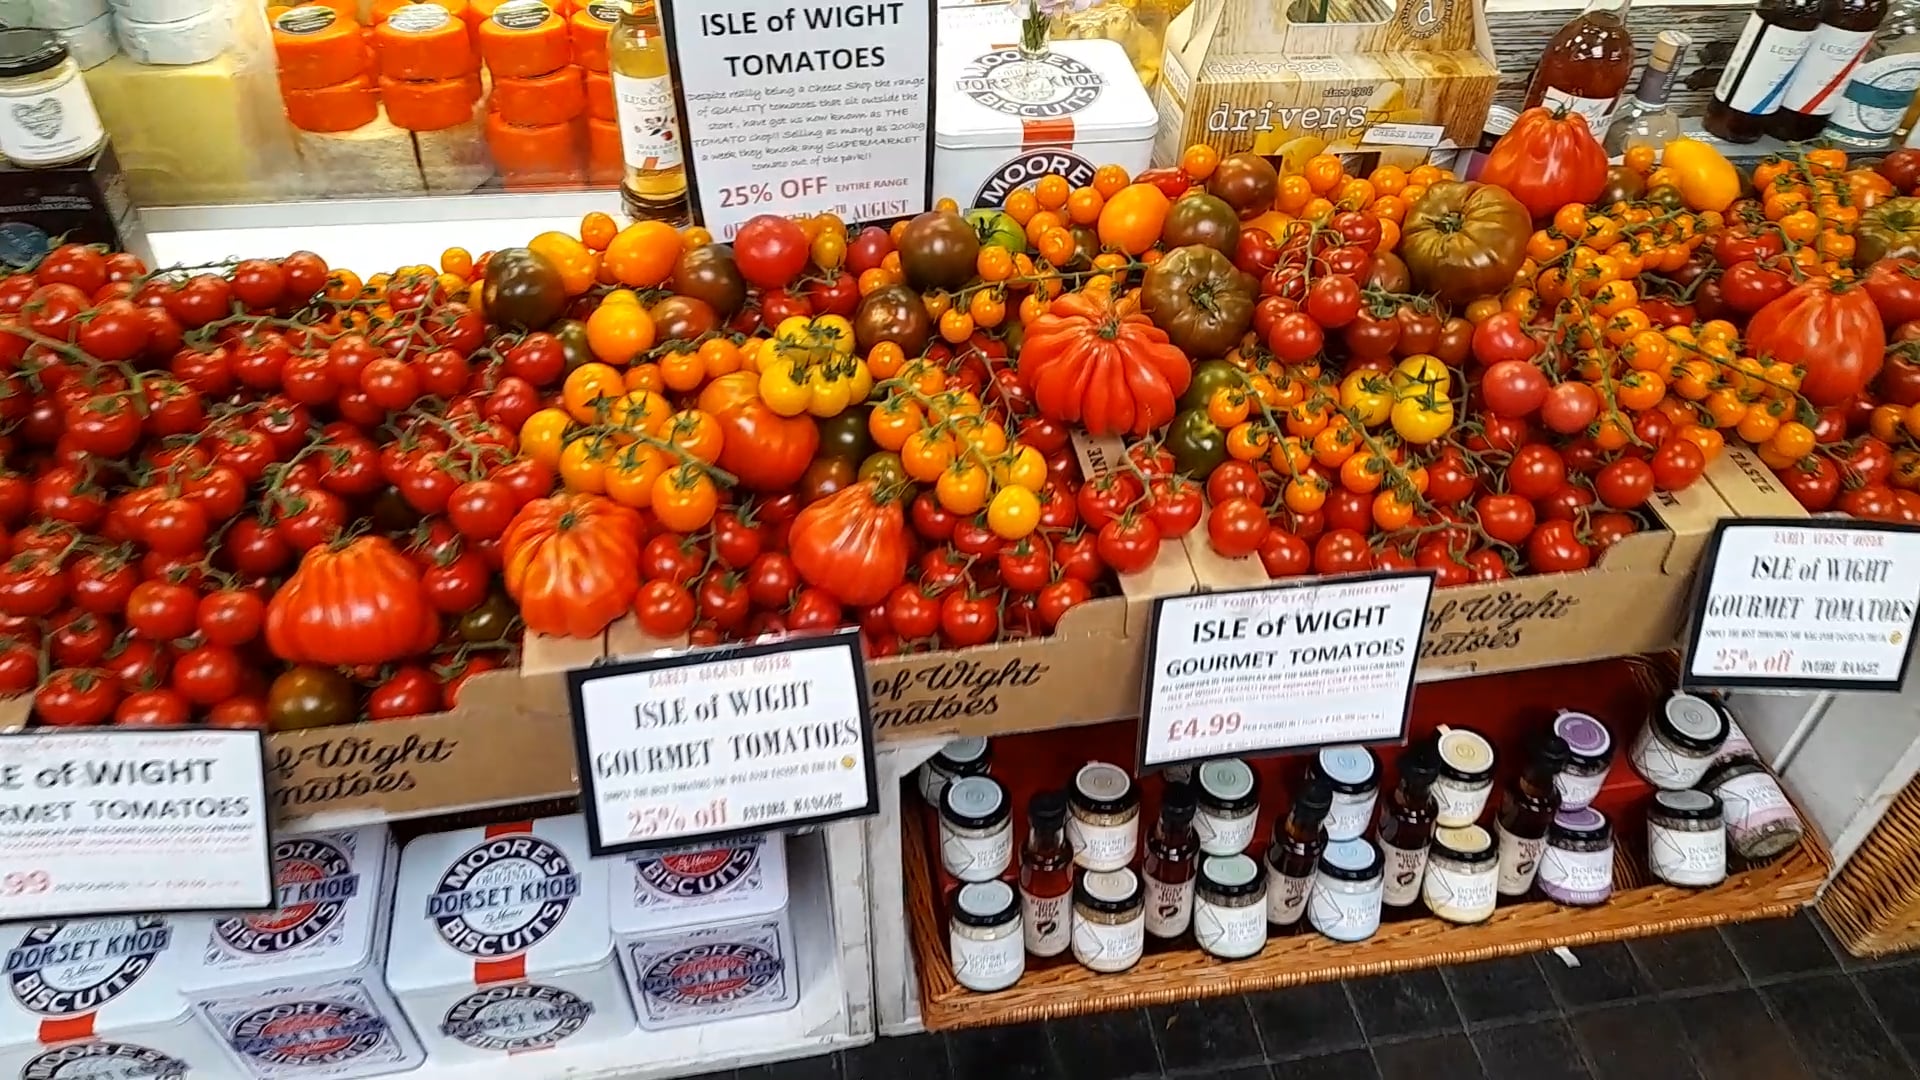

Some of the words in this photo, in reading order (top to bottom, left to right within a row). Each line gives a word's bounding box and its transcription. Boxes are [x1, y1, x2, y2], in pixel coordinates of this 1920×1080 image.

[701, 12, 757, 37] ISLE
[767, 8, 796, 32] of
[803, 2, 904, 30] WIGHT
[723, 46, 885, 77] TOMATOES
[961, 50, 1085, 79] MOOES
[687, 91, 726, 102] Despite
[729, 88, 761, 101] really
[765, 85, 795, 97] being
[808, 83, 842, 93] Cheese
[845, 81, 872, 92] Shop
[874, 79, 890, 88] the
[894, 78, 925, 88] range
[1046, 73, 1104, 89] KNOB
[1322, 88, 1350, 98] since
[697, 106, 708, 118] of
[710, 104, 767, 115] QUALITY
[769, 101, 817, 111] tomatoes
[819, 98, 841, 107] that
[844, 97, 858, 105] sit
[861, 92, 899, 104] outside
[902, 92, 918, 101] the
[975, 87, 1097, 116] BISCUITS
[1208, 101, 1368, 132] drivers
[743, 118, 767, 127] have
[769, 118, 787, 128] got
[807, 114, 827, 123] now
[830, 113, 868, 121] known
[885, 108, 909, 117] THE
[1371, 128, 1407, 139] CHEESE
[692, 135, 746, 147] TOMATO
[782, 127, 823, 139] Selling
[840, 127, 873, 137] many
[711, 151, 737, 160] week
[739, 148, 762, 159] they
[765, 144, 799, 154] knock
[802, 143, 823, 154] any
[826, 136, 921, 150] SUPERMARKET
[751, 160, 788, 171] tomato
[790, 159, 808, 167] out
[809, 155, 821, 167] of
[822, 154, 838, 164] the
[718, 182, 773, 208] 25%
[780, 176, 828, 199] OFF
[835, 182, 871, 193] ENTIRE
[873, 178, 909, 189] RANGE
[981, 156, 1093, 205] MOORE
[852, 199, 909, 220] AUGUST
[1751, 555, 1795, 580] ISLE
[1799, 557, 1822, 581] of
[1826, 557, 1893, 583] WIGHT
[1193, 617, 1249, 644] ISLE
[1257, 613, 1288, 638] of
[1296, 604, 1391, 635] WIGHT
[1460, 589, 1580, 631] Wight
[1708, 594, 1804, 620] GOURMET
[1814, 596, 1914, 623] TOMATOES
[1166, 650, 1278, 678] GOURMET
[1290, 638, 1405, 666] TOMATOES
[1713, 648, 1757, 671] 25%
[1763, 648, 1794, 672] off
[872, 669, 913, 701] of
[915, 657, 1050, 699] Wight
[634, 696, 688, 730] ISLE
[695, 693, 719, 722] of
[729, 680, 813, 718] WIGHT
[870, 694, 1000, 729] matoes
[1167, 712, 1242, 743] £4.99
[302, 734, 459, 775] Wight
[597, 736, 714, 779] GOURMET
[727, 717, 859, 762] TOMATOES
[34, 760, 77, 789] of
[86, 758, 219, 786] WIGHT
[88, 796, 250, 820] TOMATOES
[628, 803, 687, 836] 25%
[694, 797, 728, 826] off
[275, 842, 345, 876] ORES
[444, 839, 566, 889] MOORES
[644, 850, 750, 895] BISCUITS
[300, 877, 354, 899] KNOB
[476, 868, 538, 886] ORIGINAL
[429, 886, 513, 916] DORSET
[521, 876, 577, 903] KNOB
[220, 902, 338, 952] BISCUITS
[442, 903, 563, 954] BISCUITS
[7, 938, 99, 971] DORSET
[105, 929, 168, 956] KNOB
[647, 945, 773, 977] MOORES
[15, 956, 148, 1013] BISCUITS
[450, 986, 576, 1021] MOORES
[235, 1003, 363, 1038] MOORES
